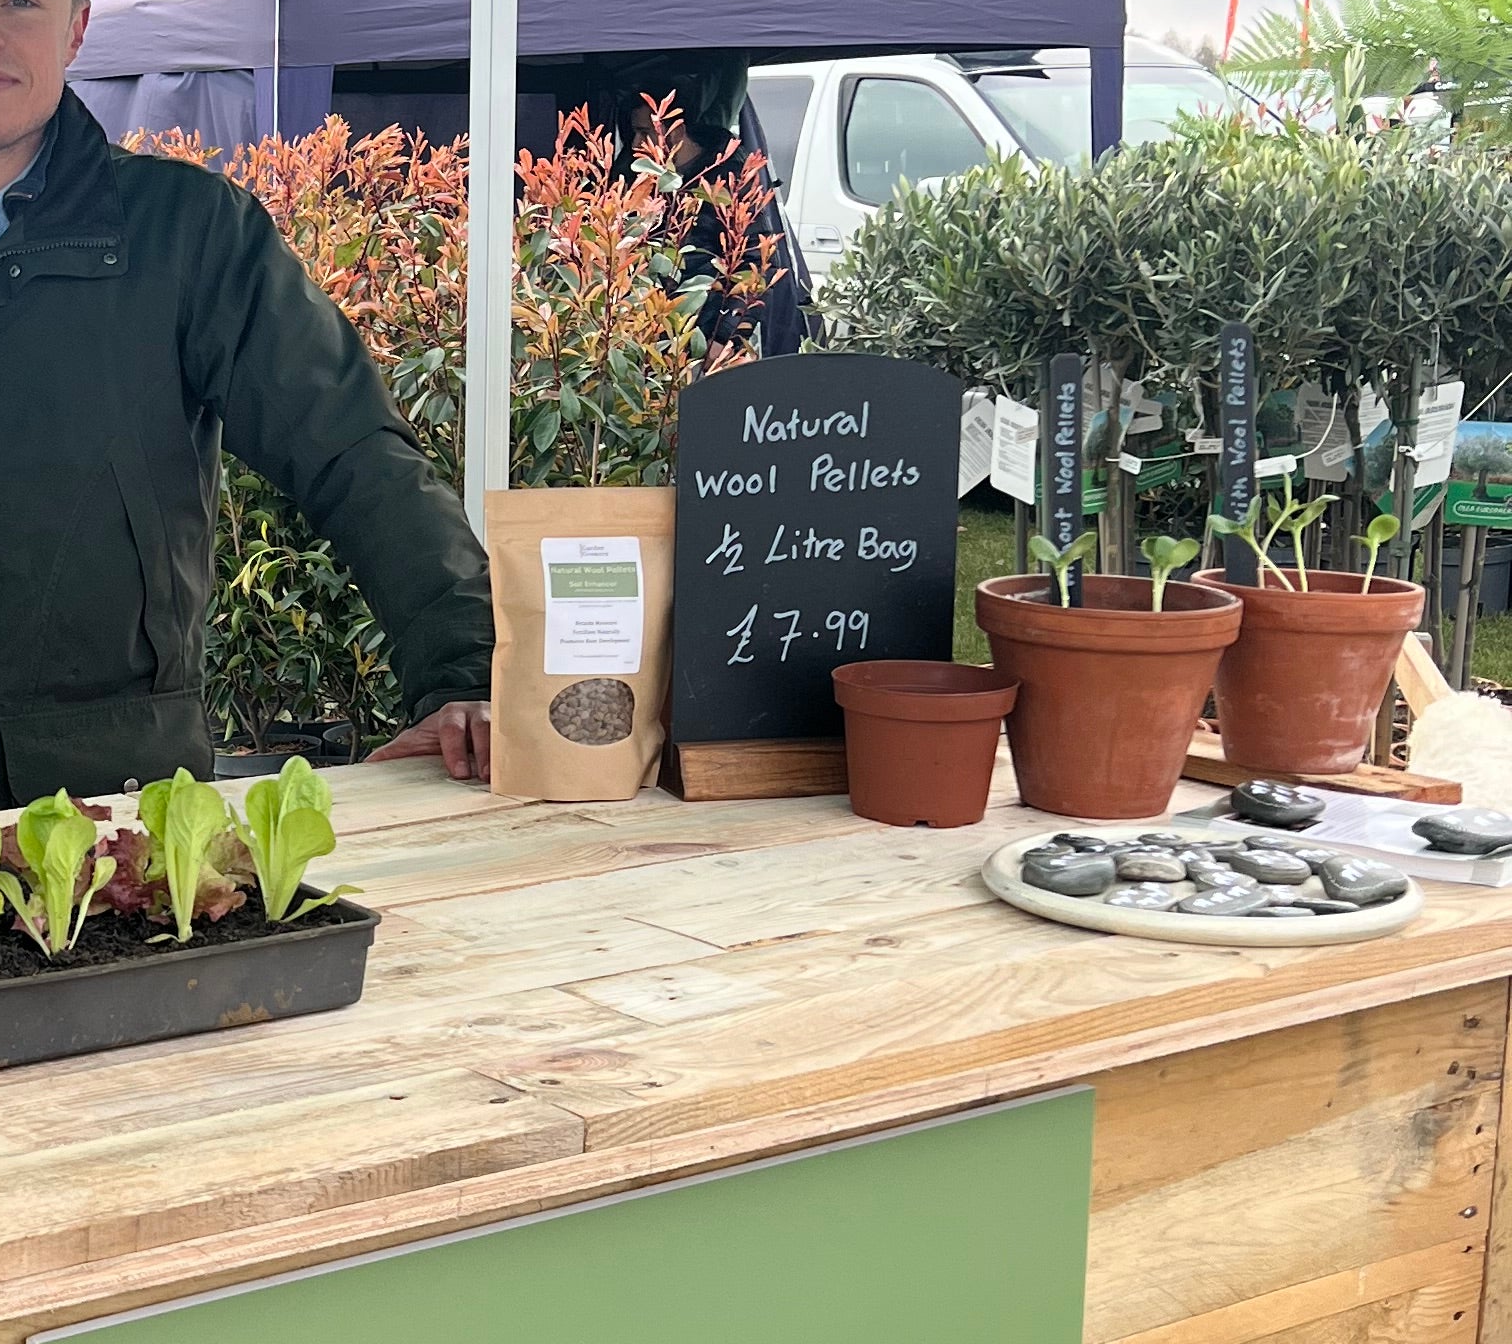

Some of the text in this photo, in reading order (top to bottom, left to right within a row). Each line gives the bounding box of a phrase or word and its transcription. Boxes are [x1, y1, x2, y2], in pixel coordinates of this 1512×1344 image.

[1226, 337, 1247, 406] Pellets
[742, 401, 869, 444] Natural
[1054, 381, 1076, 446] Pellets
[1228, 418, 1248, 466] Wool
[810, 453, 920, 492] Pellets
[1054, 451, 1076, 494] Wool
[764, 524, 845, 565] Litre
[857, 526, 917, 572] Bag
